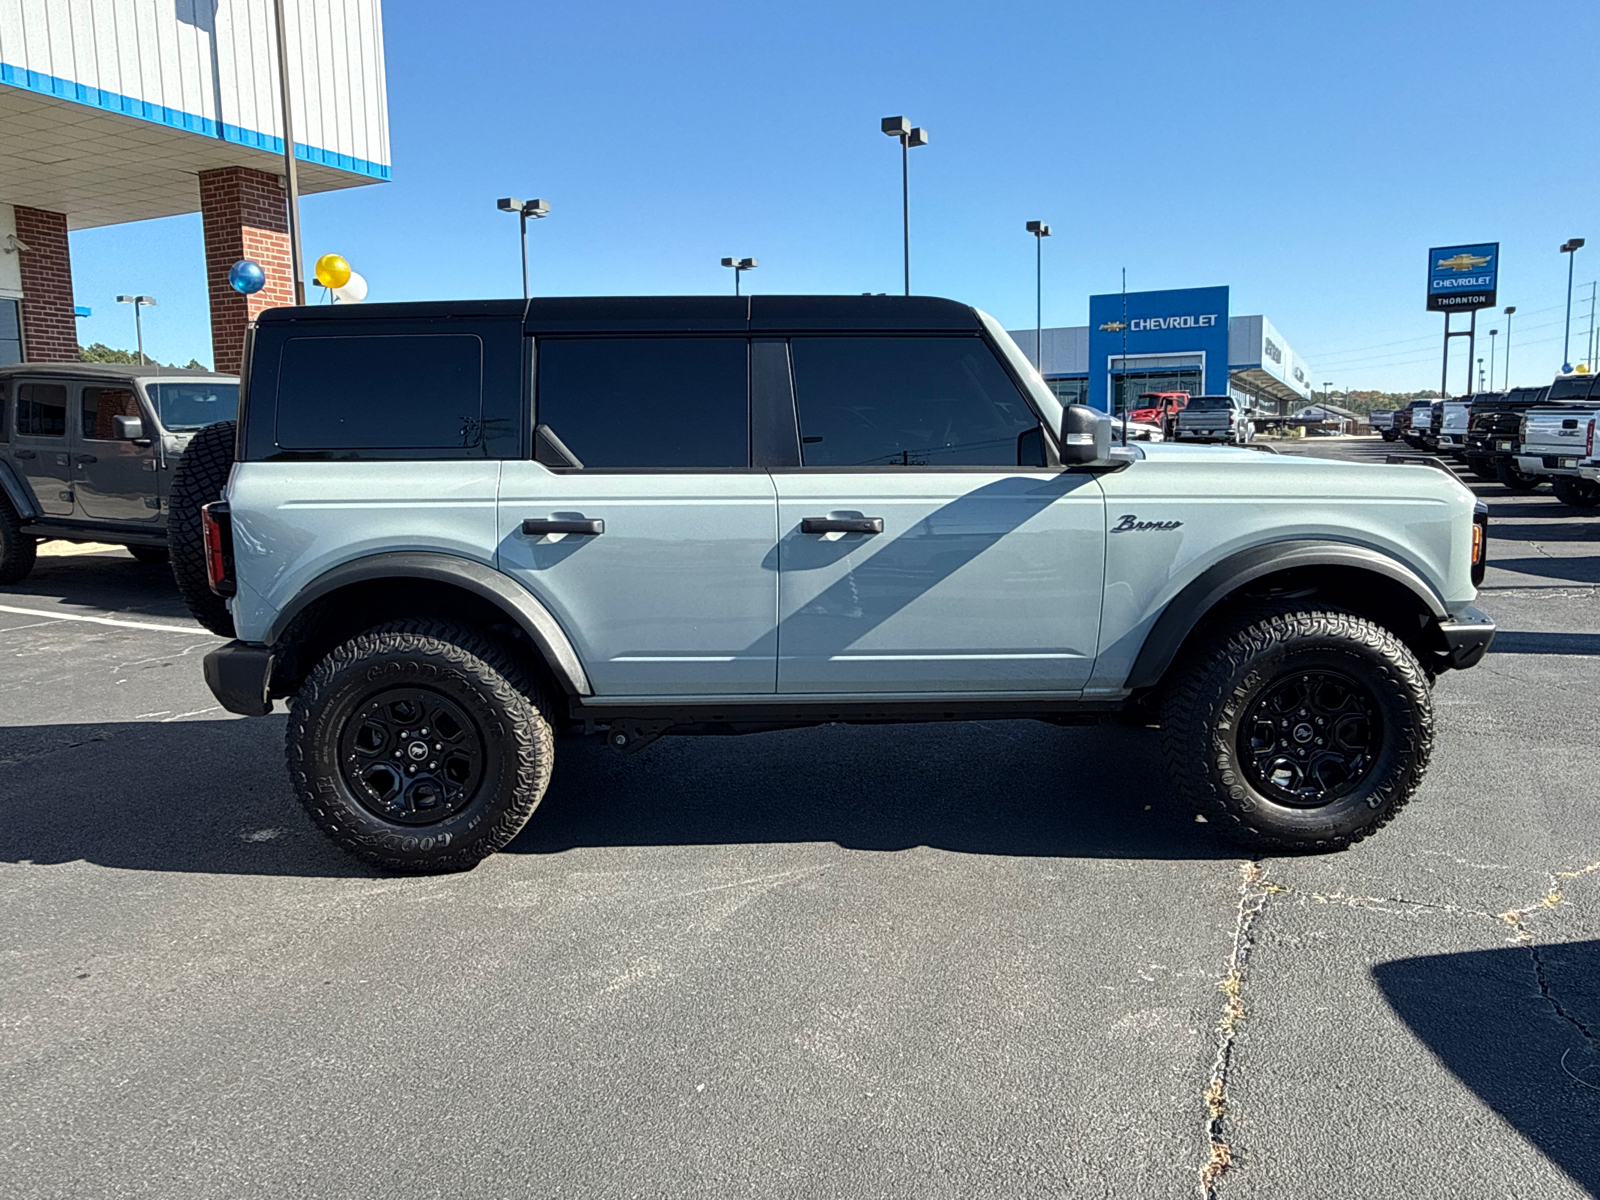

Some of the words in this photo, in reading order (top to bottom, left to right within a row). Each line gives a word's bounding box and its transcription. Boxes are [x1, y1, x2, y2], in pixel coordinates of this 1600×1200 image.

[1433, 276, 1491, 288] CHEVROLET
[1437, 295, 1486, 306] THORNTON
[1130, 313, 1218, 332] CHEVROLET
[1558, 429, 1581, 437] GMC
[1110, 514, 1184, 532] Bronco
[366, 661, 506, 738] GOODYEAR
[1212, 669, 1262, 813] GOODYEAR
[316, 775, 454, 853] GOODYEAR
